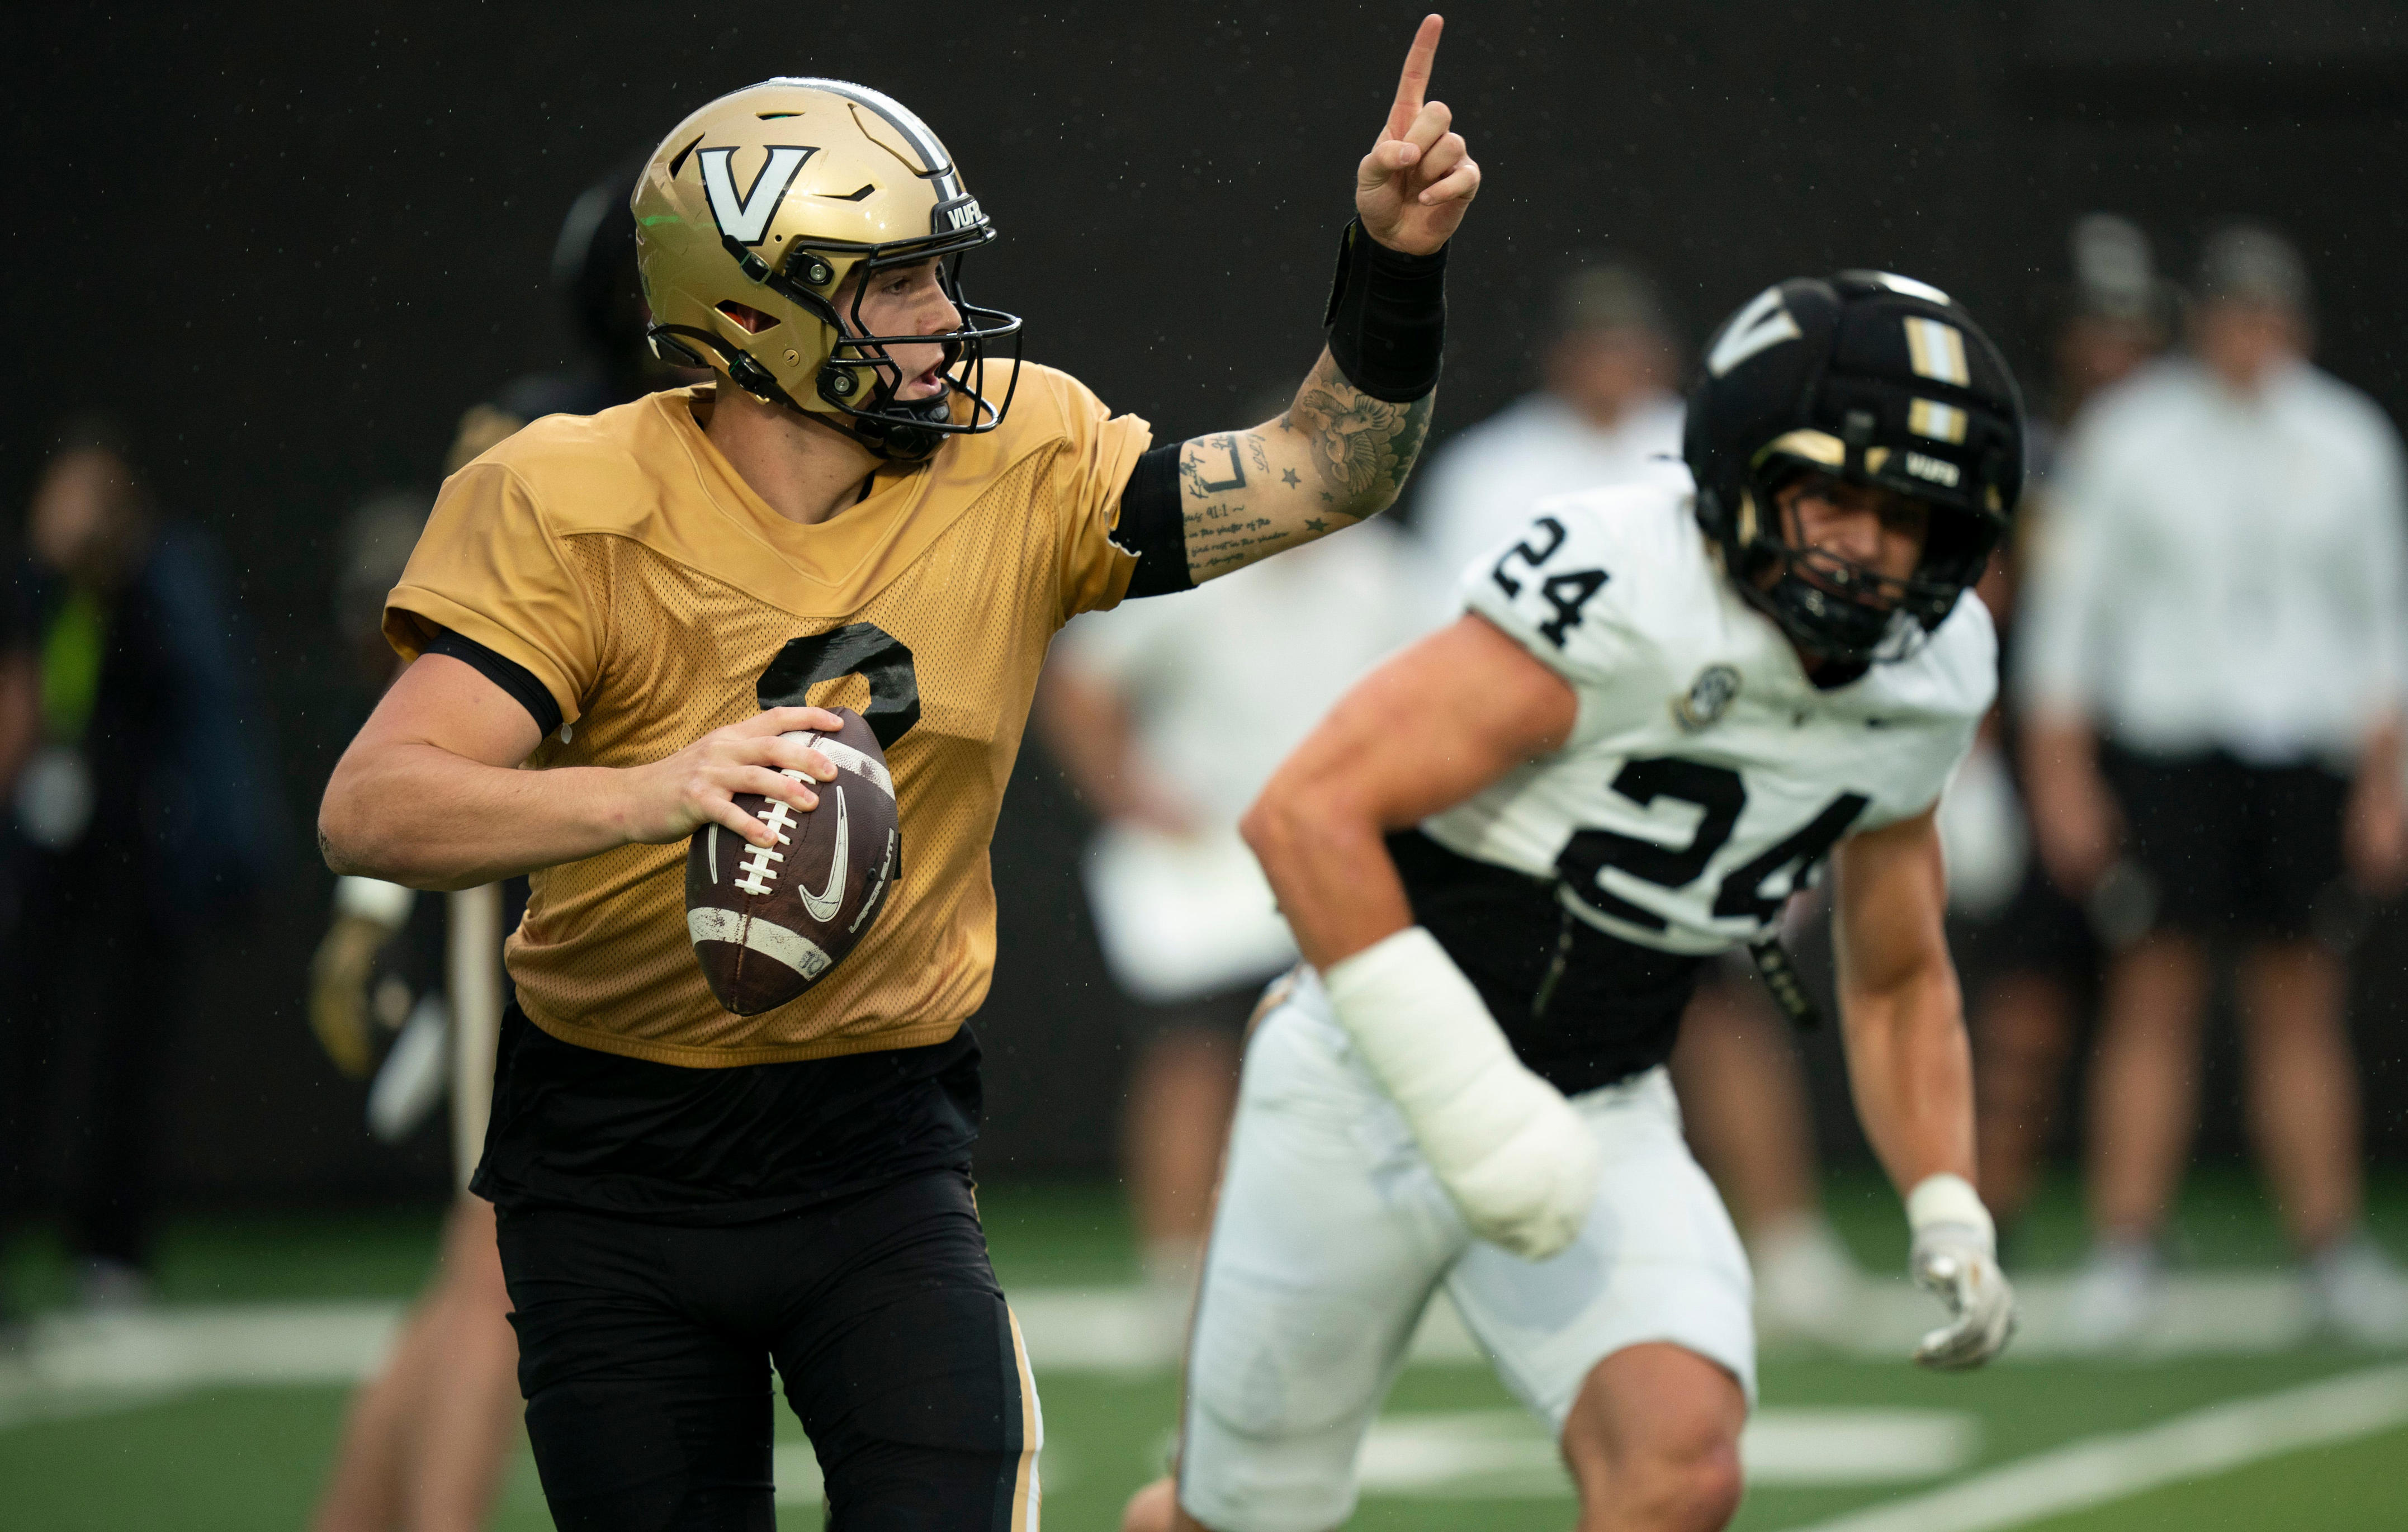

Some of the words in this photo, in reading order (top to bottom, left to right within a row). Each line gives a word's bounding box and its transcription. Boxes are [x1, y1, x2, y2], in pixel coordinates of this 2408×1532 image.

[696, 145, 820, 246] V
[947, 200, 982, 230] VUFB
[1708, 285, 1803, 379] V
[1207, 504, 1228, 519] 91:1
[1492, 518, 1610, 649] 24
[1557, 756, 1871, 933] 24
